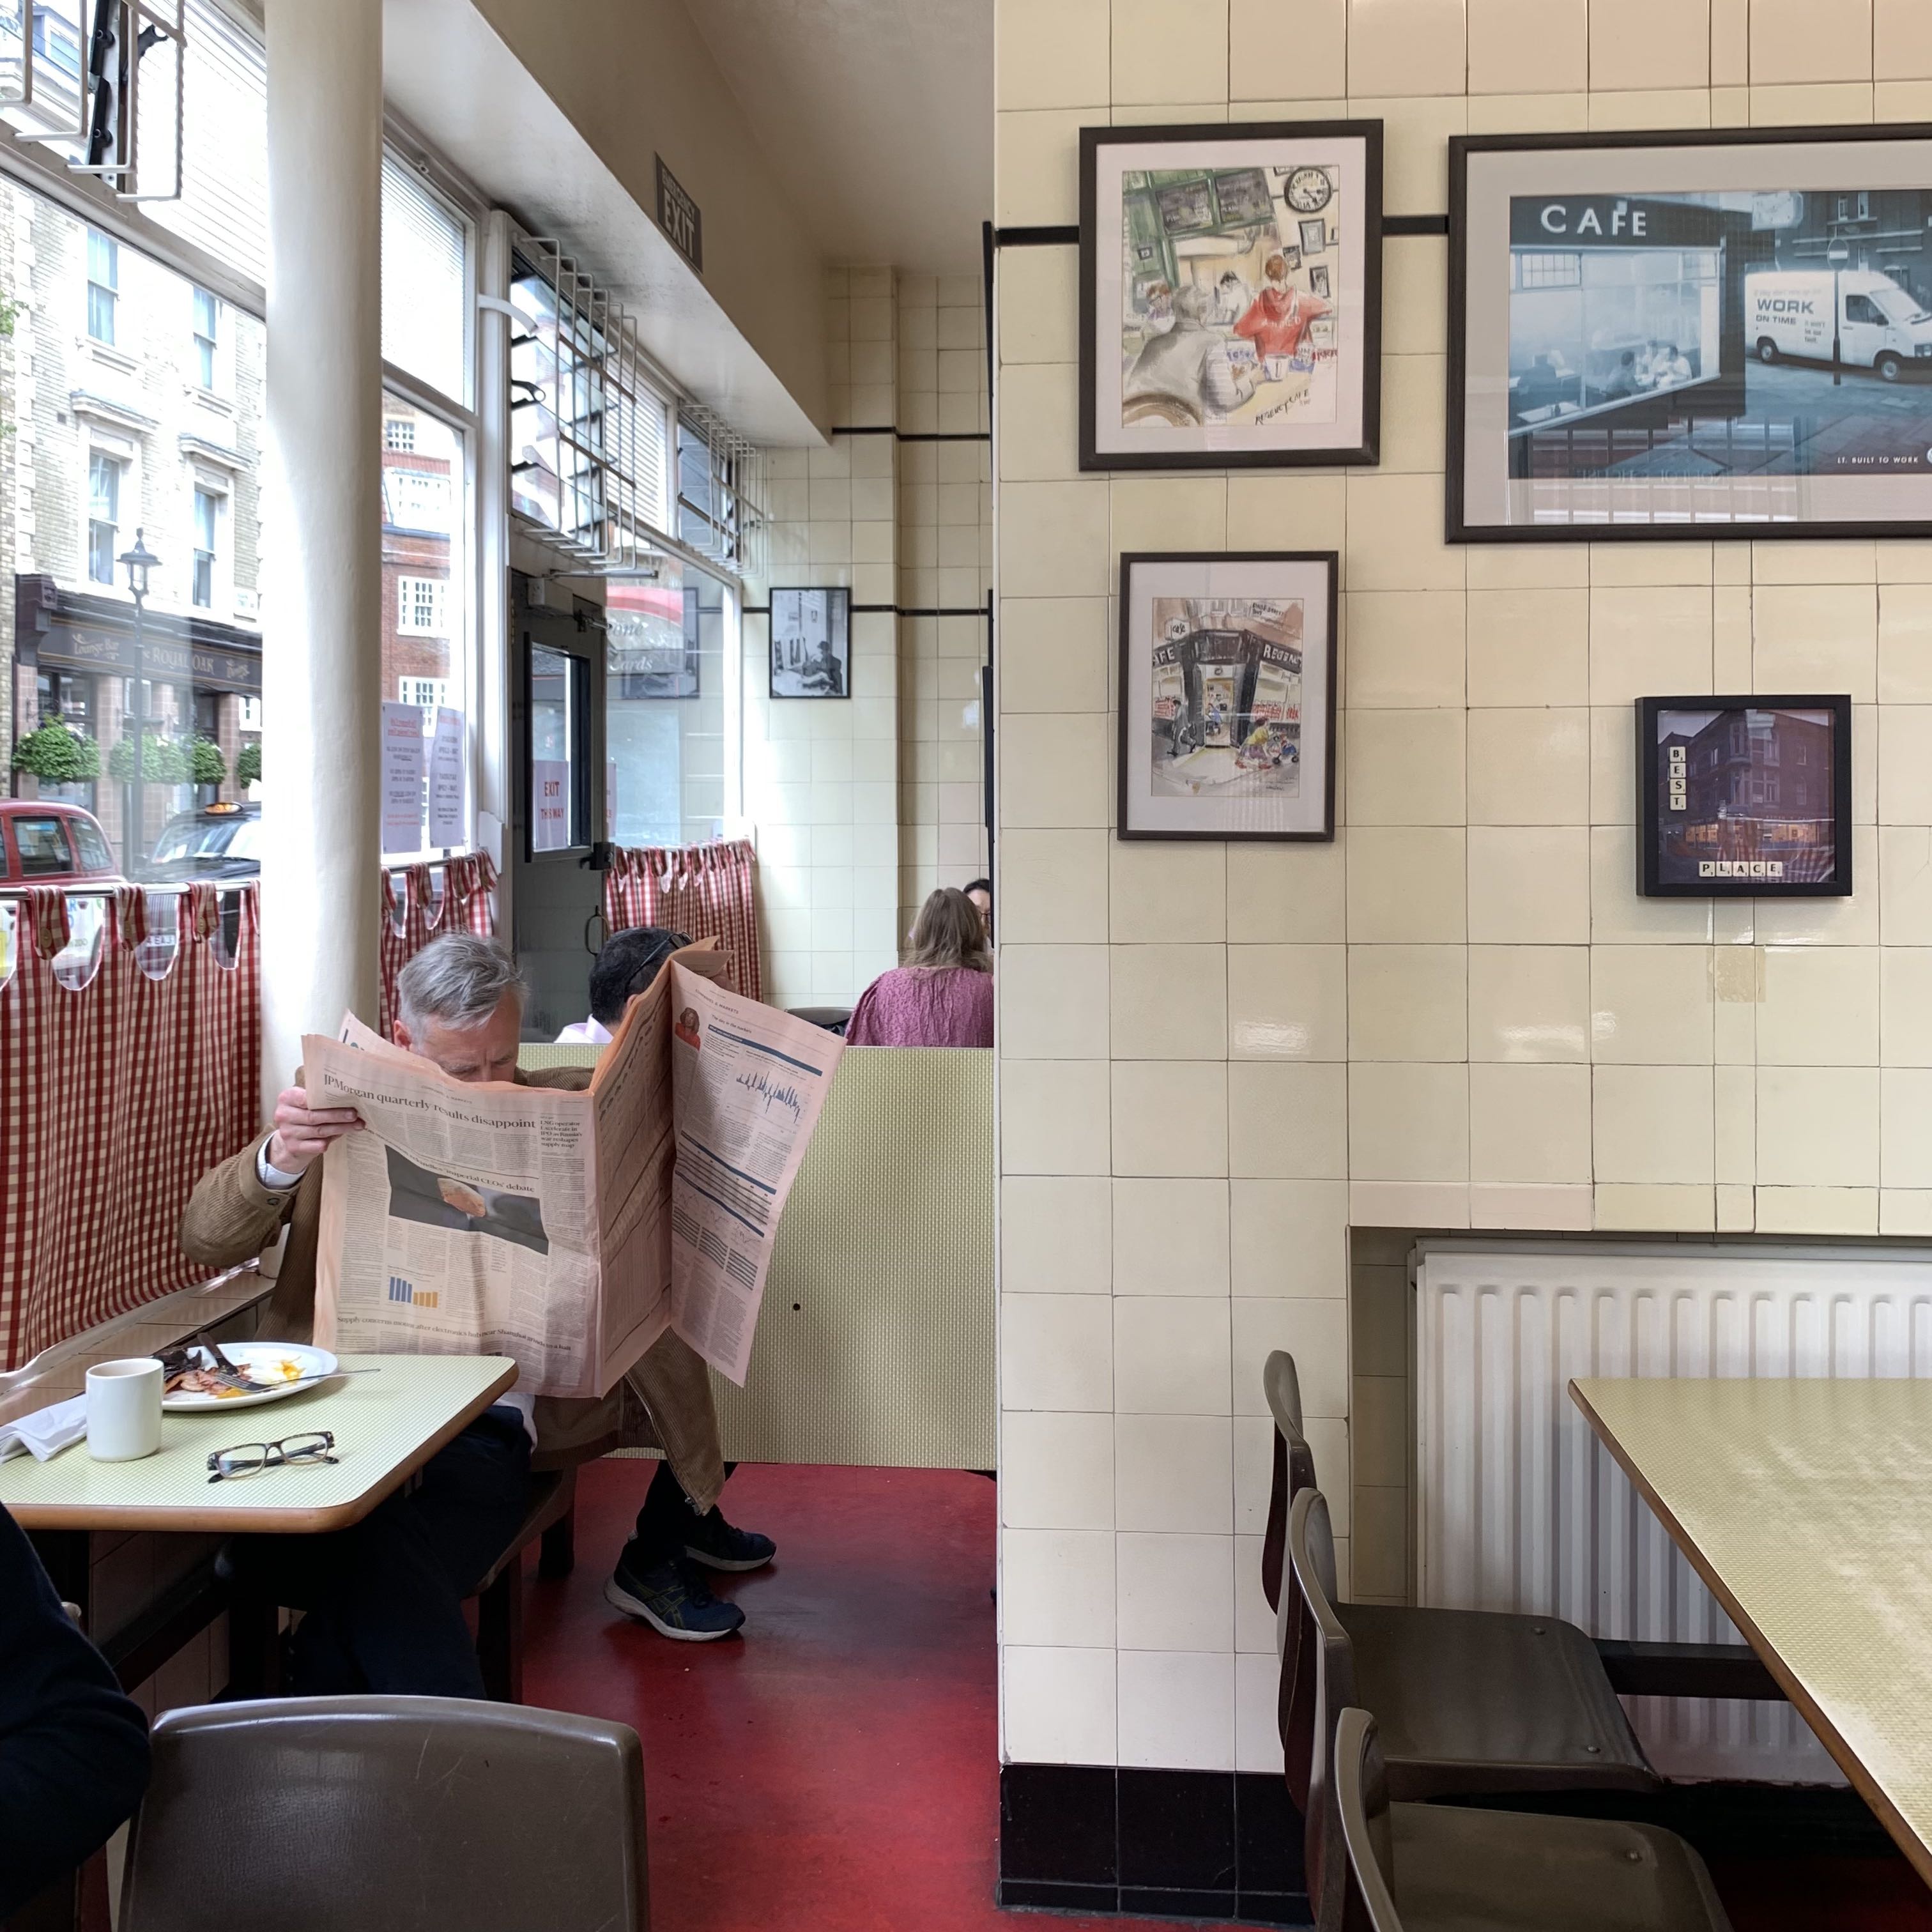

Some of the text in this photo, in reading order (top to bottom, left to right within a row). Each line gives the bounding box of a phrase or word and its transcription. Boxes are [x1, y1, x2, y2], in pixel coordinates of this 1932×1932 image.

[664, 188, 695, 259] EXIT
[1540, 204, 1646, 237] CAFE
[1757, 298, 1814, 314] WORK
[1756, 314, 1797, 325] ON TIME
[1851, 456, 1875, 464] BUILT
[1879, 456, 1889, 464] TO
[1893, 456, 1919, 464] WORK
[193, 654, 215, 675] OAK
[1673, 749, 1685, 808] BEST
[544, 781, 560, 797] EXIT
[553, 808, 564, 818] WAY
[1702, 862, 1780, 875] PLACE
[325, 1074, 536, 1128] JPMorgan quarterly results disappoint
[506, 1183, 535, 1193] debate
[337, 1316, 360, 1324] Supply
[432, 1327, 467, 1337] electronics
[497, 1329, 526, 1339] Shanghai
